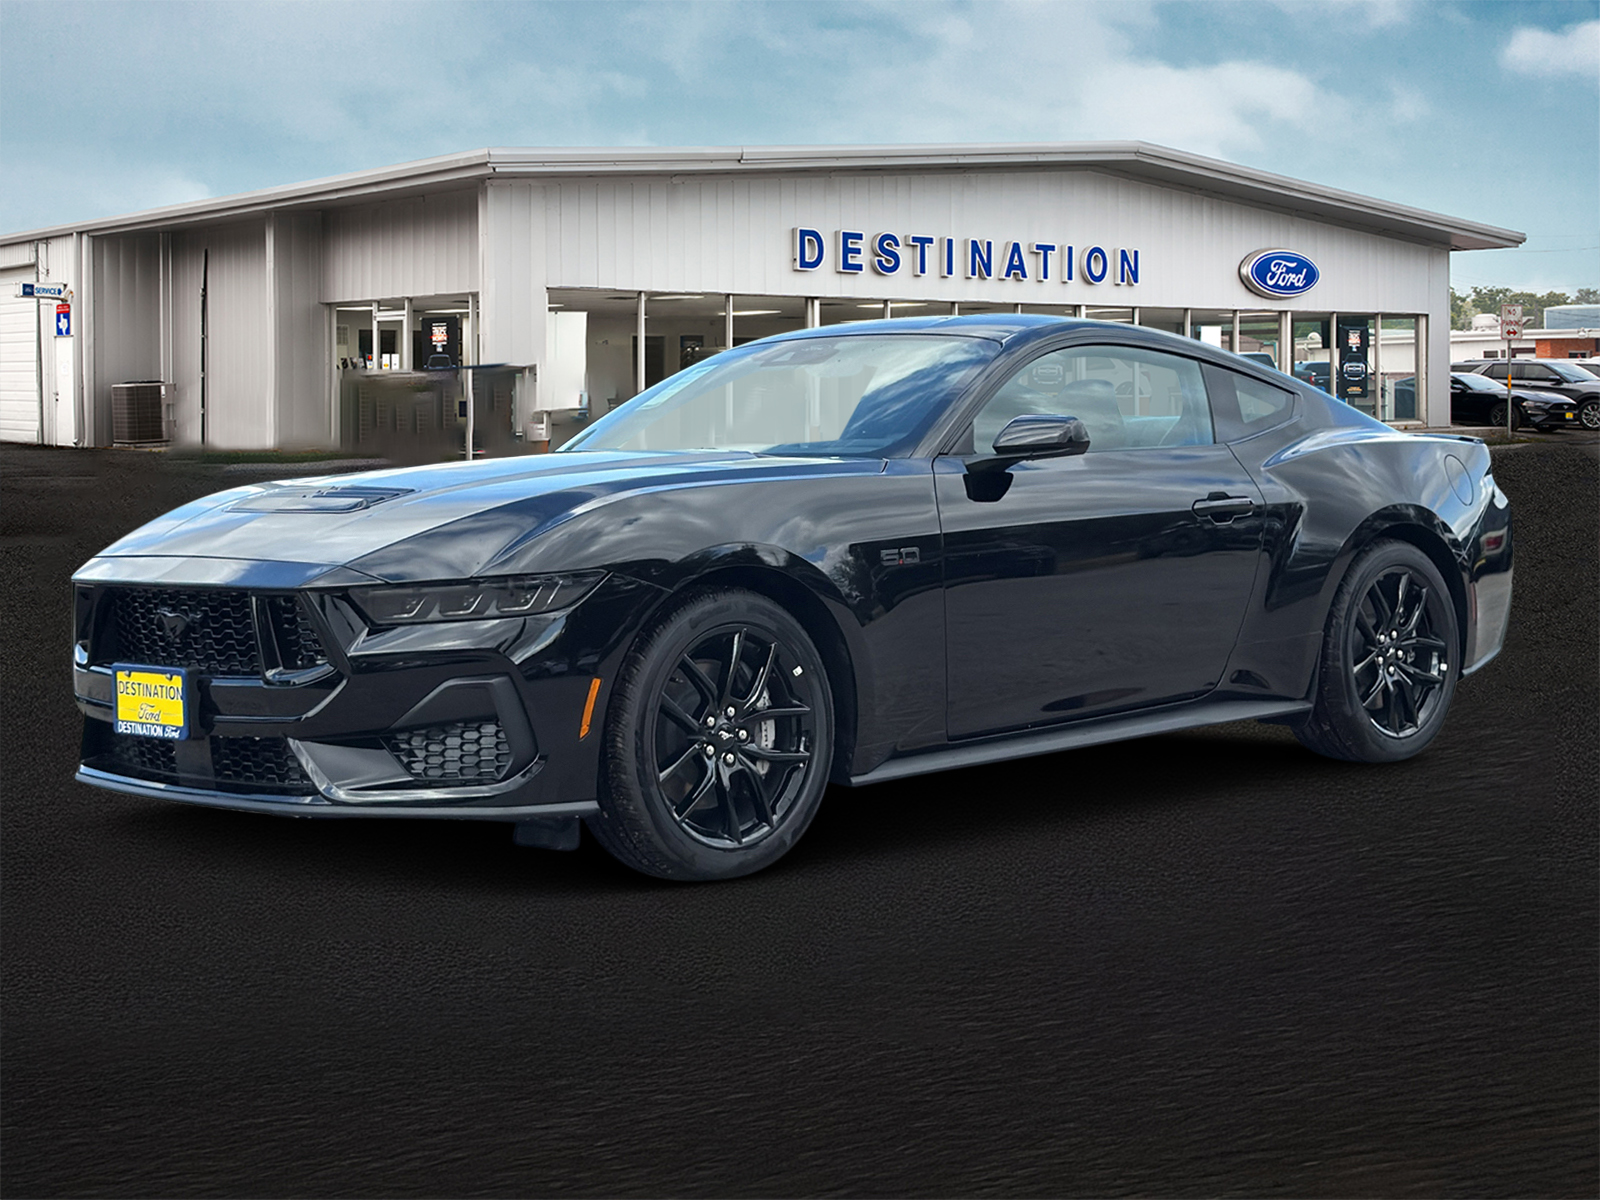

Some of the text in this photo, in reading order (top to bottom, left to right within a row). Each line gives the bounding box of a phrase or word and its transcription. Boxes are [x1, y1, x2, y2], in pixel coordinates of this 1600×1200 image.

[793, 226, 1141, 286] DESTINATION
[1266, 260, 1307, 287] Ford
[35, 286, 57, 296] SERVICE
[119, 680, 183, 701] DESTINATION
[138, 702, 161, 722] Ford
[117, 720, 180, 739] DESTINATION Ford
